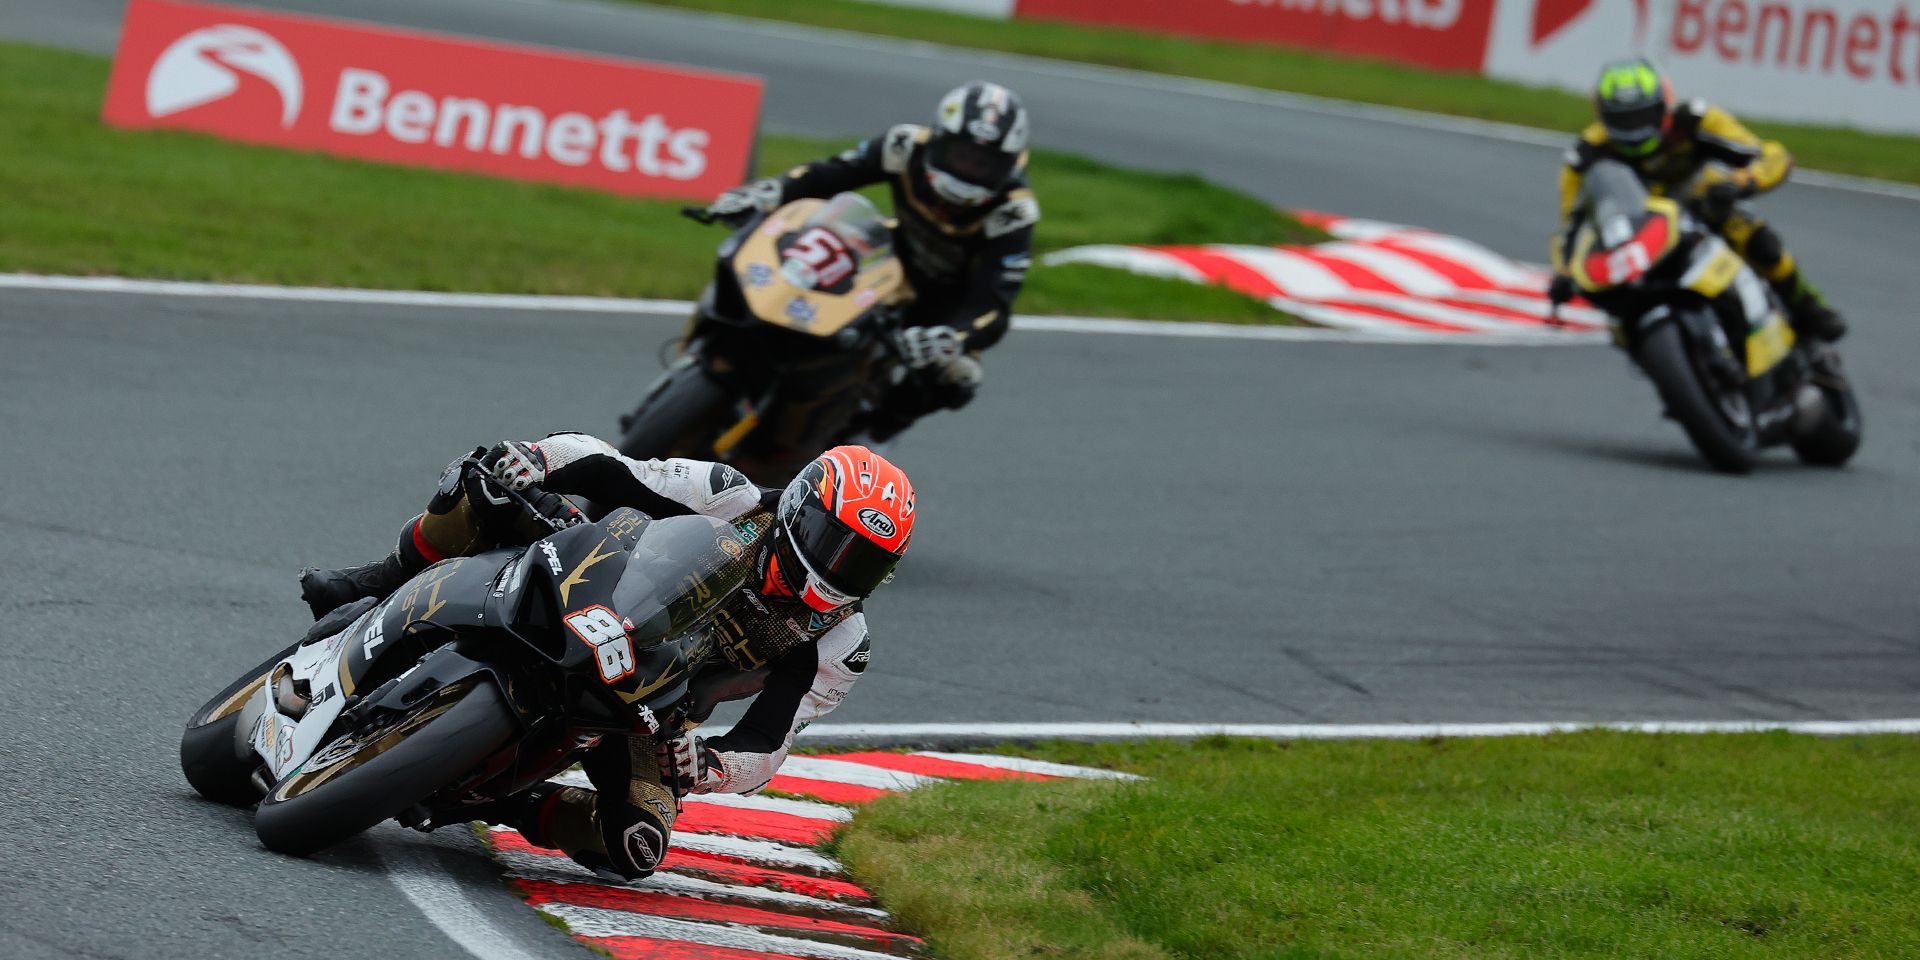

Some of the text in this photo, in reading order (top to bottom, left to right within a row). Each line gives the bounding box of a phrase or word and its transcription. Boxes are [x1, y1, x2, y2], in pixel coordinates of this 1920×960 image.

[1670, 0, 1920, 82] Bennet
[330, 67, 710, 180] Bennetts
[783, 226, 855, 287] 51
[610, 513, 643, 541] RICH
[861, 512, 892, 532] Arai
[539, 541, 563, 576] XPEL
[742, 588, 770, 615] RST
[563, 604, 636, 684] 86
